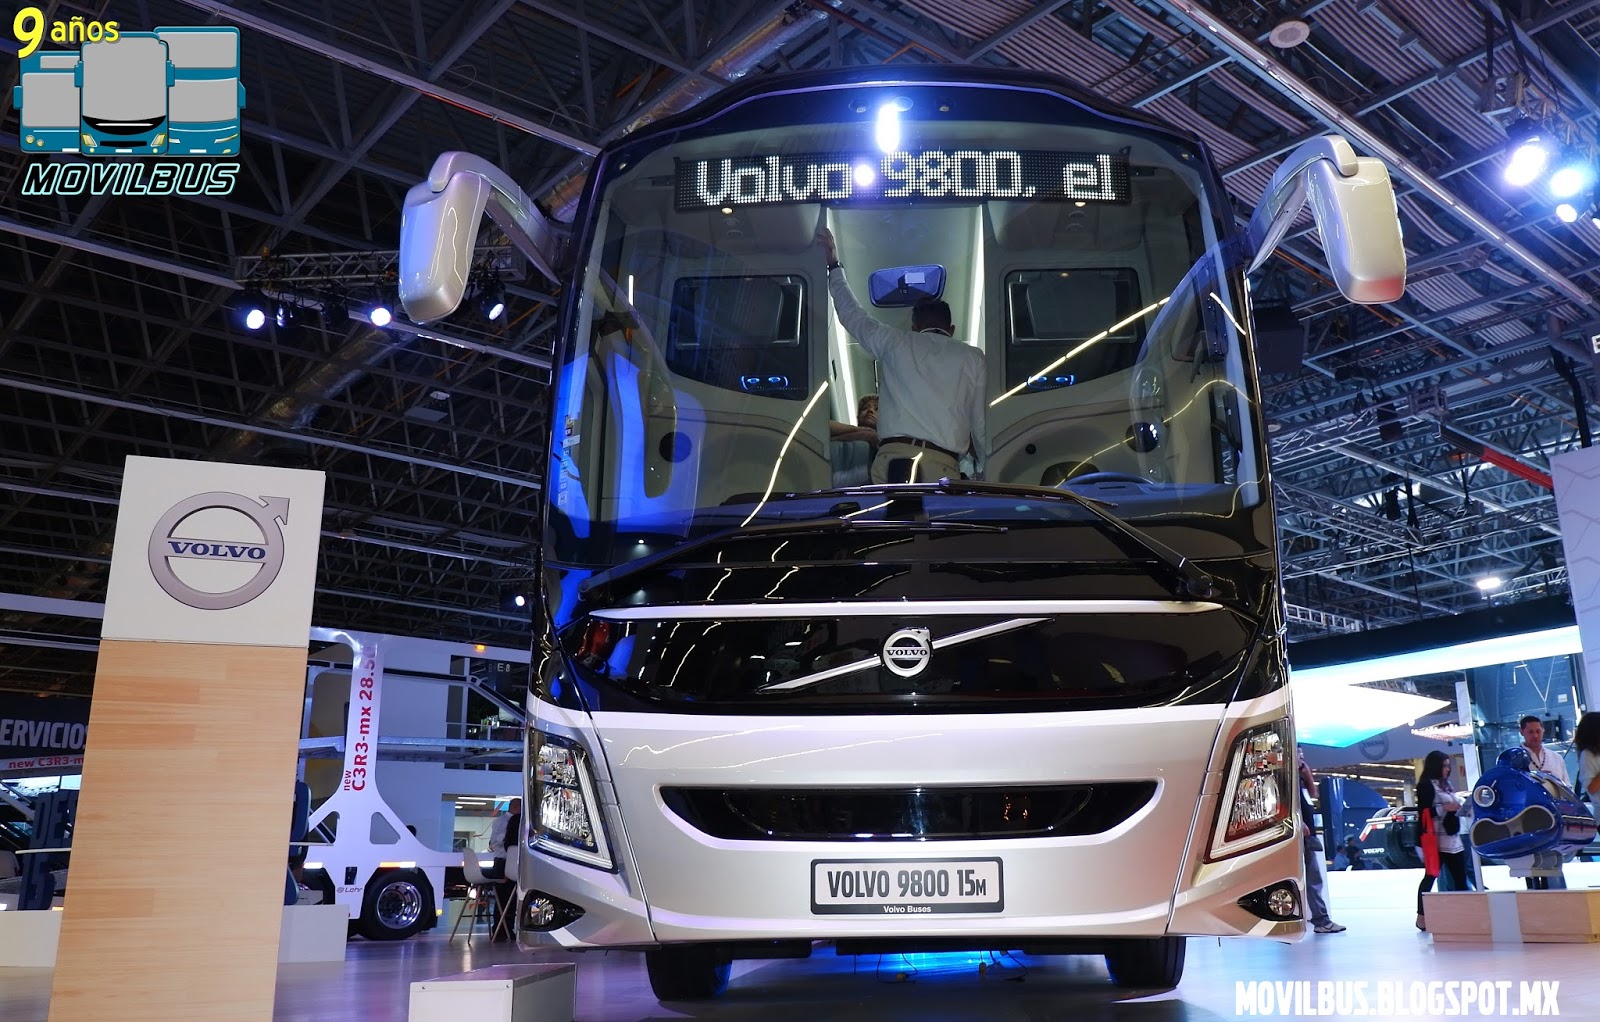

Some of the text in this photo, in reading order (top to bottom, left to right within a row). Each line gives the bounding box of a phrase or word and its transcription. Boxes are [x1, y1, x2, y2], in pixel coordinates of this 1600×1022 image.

[697, 156, 852, 206] Volvo
[1063, 154, 1116, 200] el
[167, 541, 266, 560] VOLVO
[0, 718, 87, 750] ERVICIO
[343, 770, 352, 791] new
[827, 870, 890, 898] VOLVO
[897, 869, 949, 897] 9800
[883, 905, 931, 914] Volvo Buses
